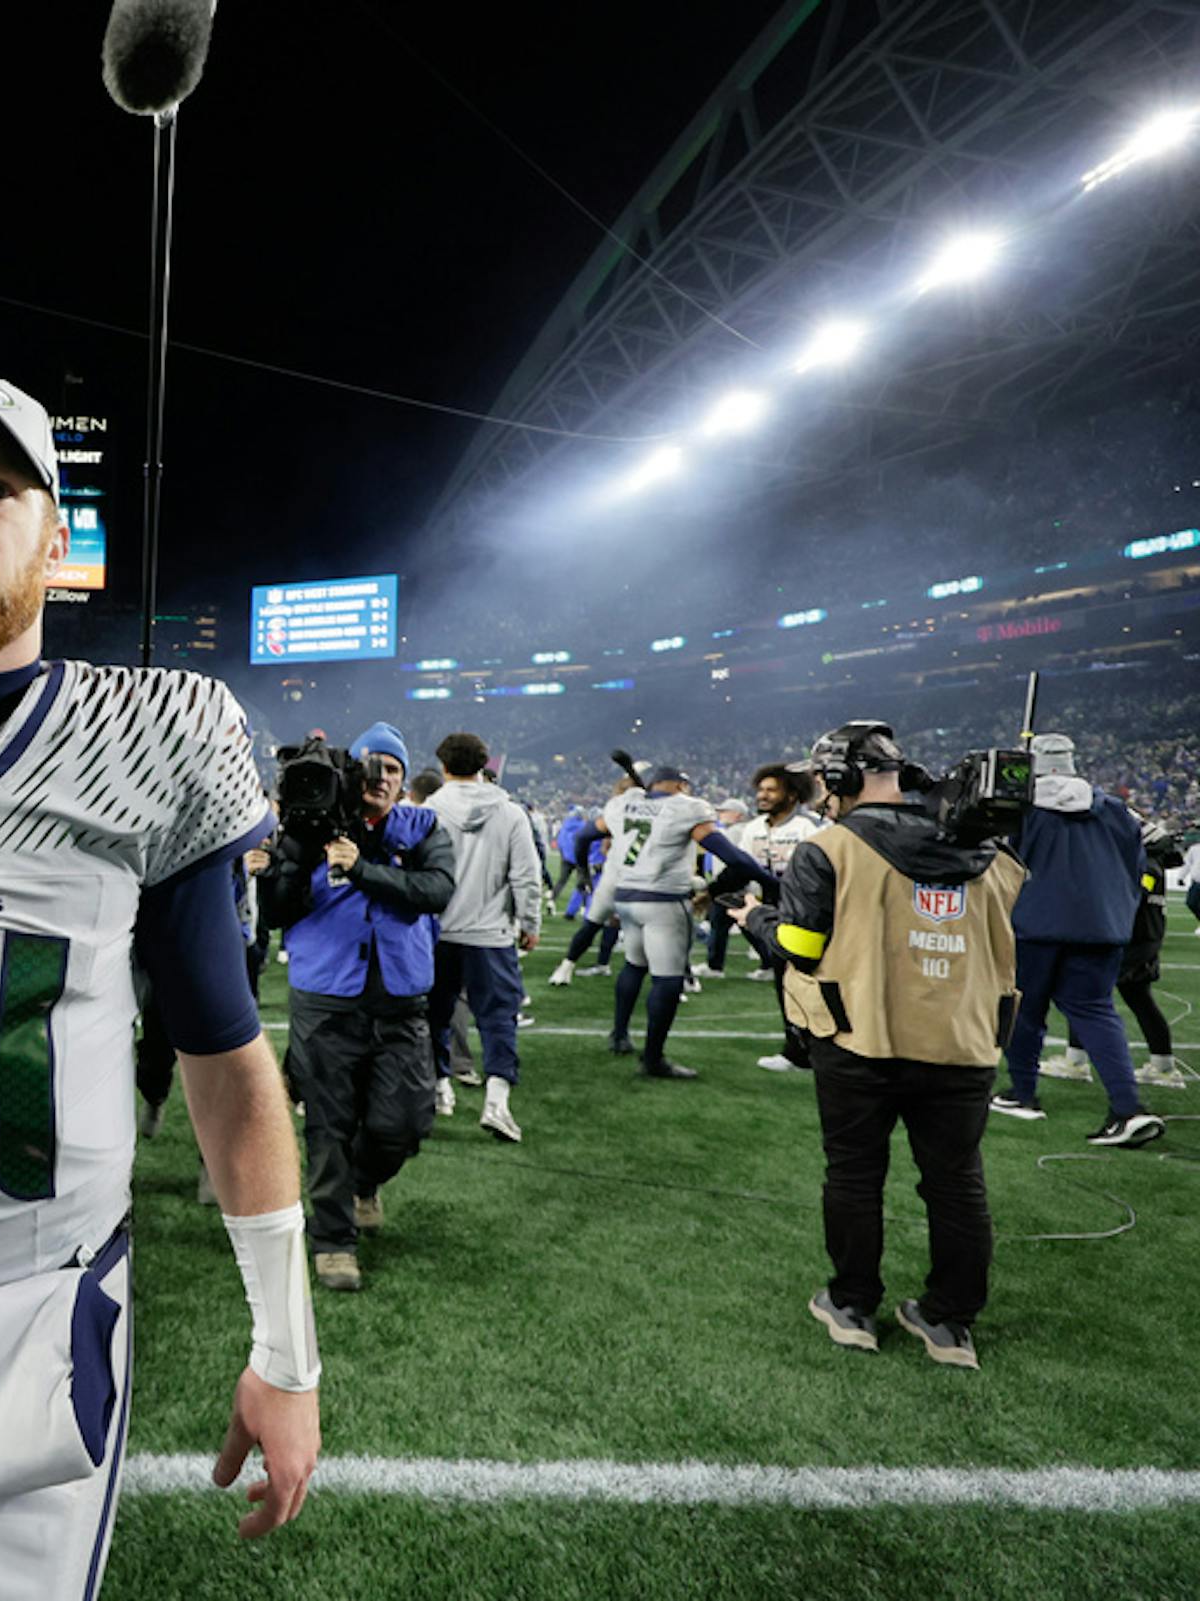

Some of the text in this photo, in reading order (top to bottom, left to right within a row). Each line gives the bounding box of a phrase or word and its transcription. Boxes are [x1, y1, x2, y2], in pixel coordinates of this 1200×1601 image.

[46, 588, 90, 603] Zillow
[997, 615, 1062, 641] Mobile
[623, 817, 652, 867] 7
[917, 890, 959, 915] NFL
[908, 930, 967, 953] MEDIA
[922, 957, 950, 979] 110
